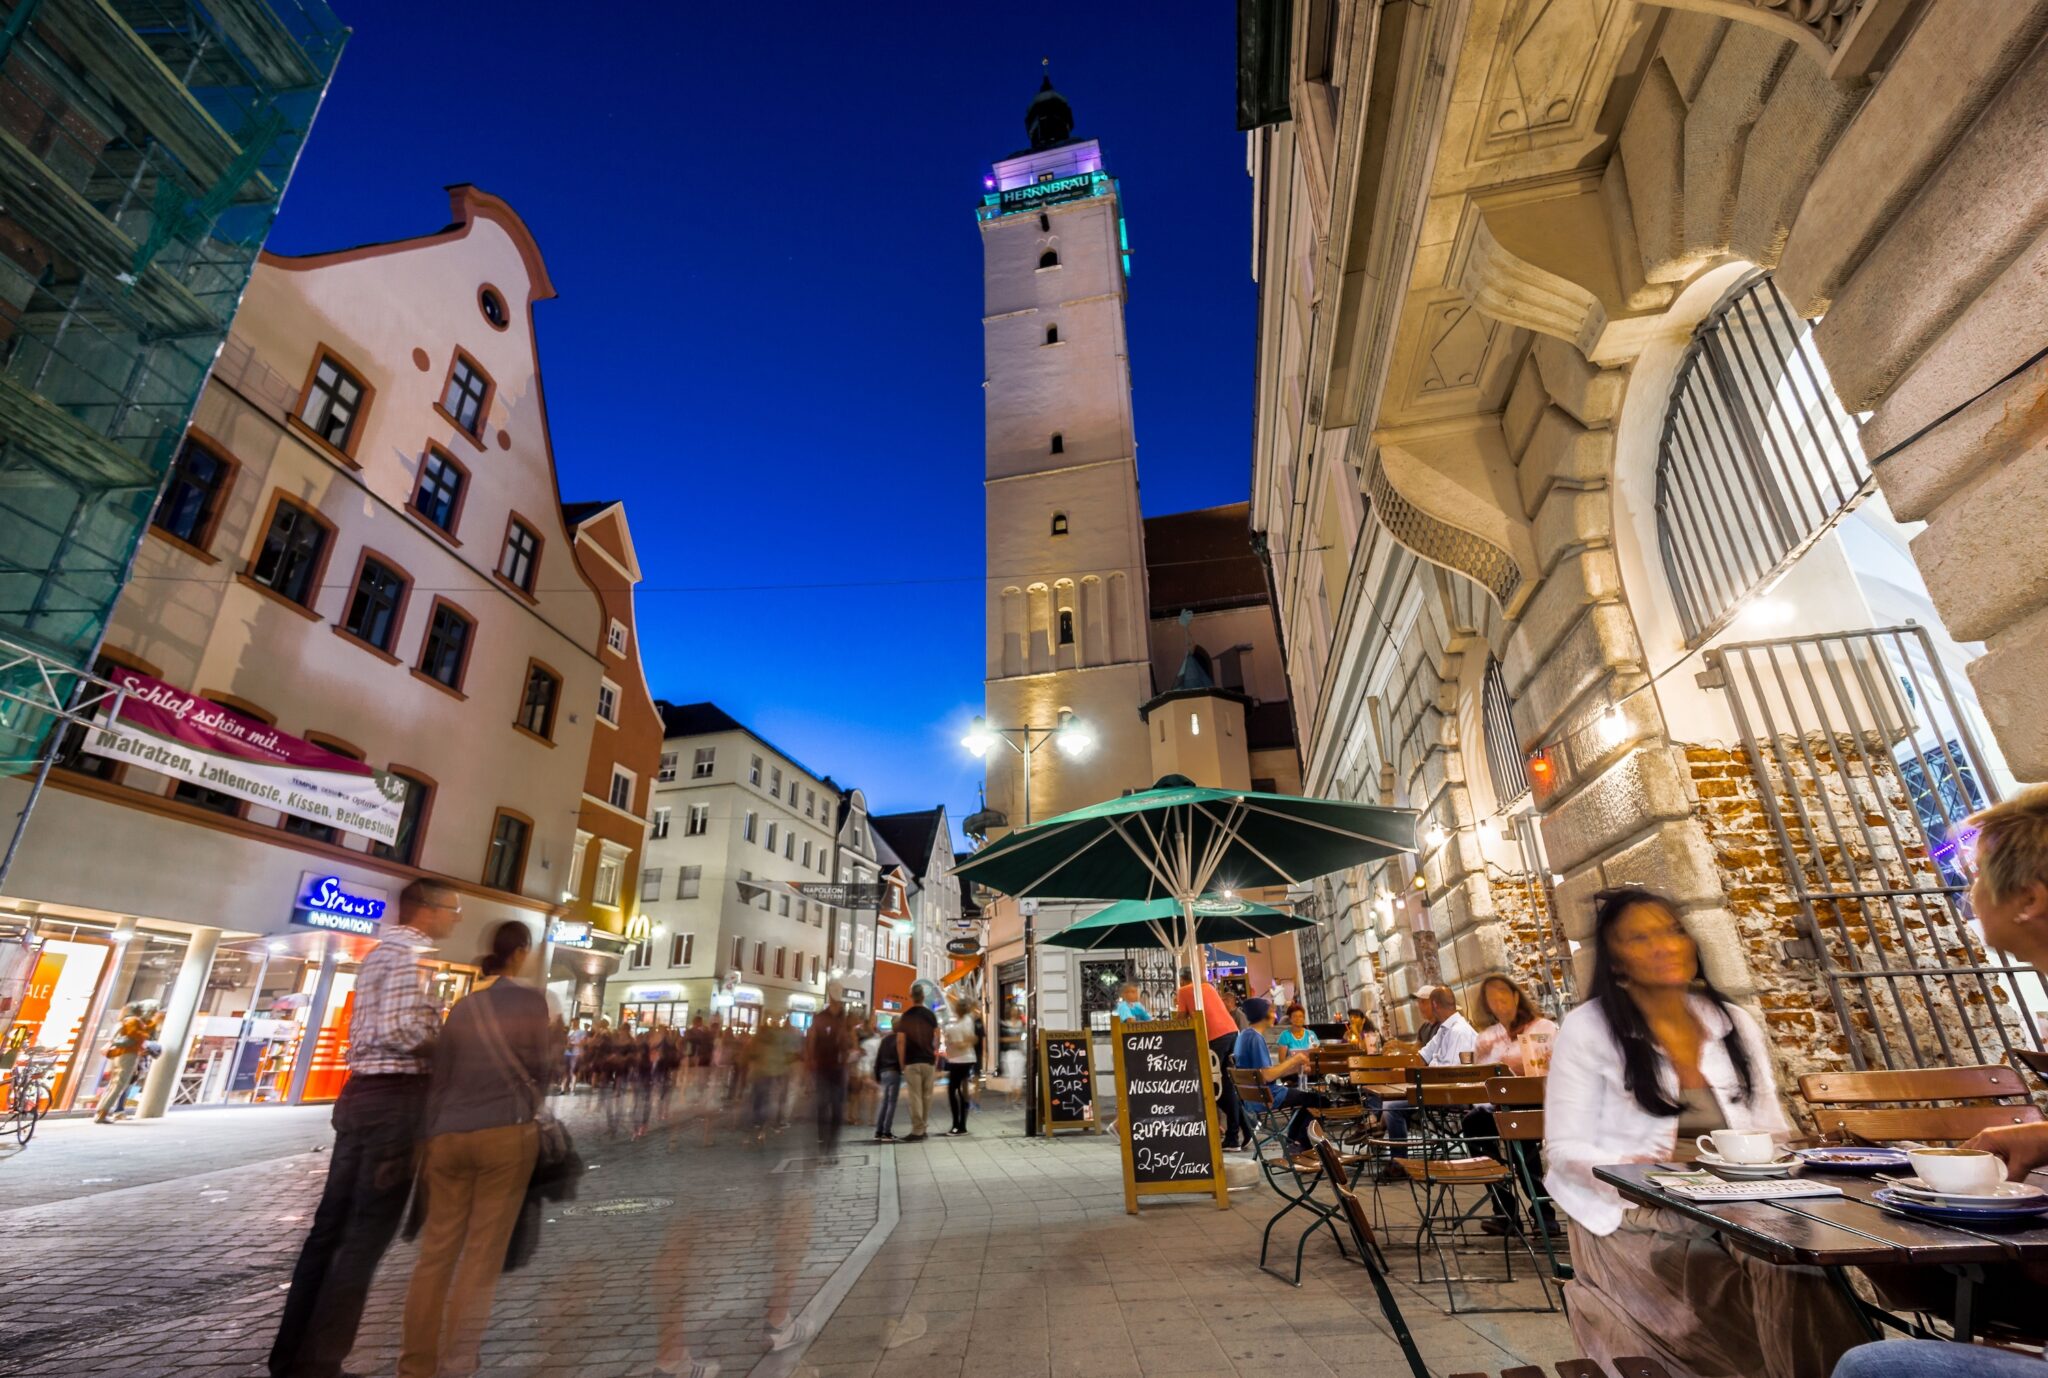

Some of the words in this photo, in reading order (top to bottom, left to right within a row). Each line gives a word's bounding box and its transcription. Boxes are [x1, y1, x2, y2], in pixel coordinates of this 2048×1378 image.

[123, 677, 195, 719] Schlaf
[191, 709, 246, 738] schön
[95, 731, 194, 775] Matratzen,
[199, 762, 283, 804] Lattenroste,
[286, 792, 332, 819] Kissen,
[336, 807, 395, 839] Bettgestelle
[310, 877, 381, 916] Straus
[803, 886, 844, 894] NAPOLEON
[308, 910, 374, 935] INNOVATION
[25, 983, 51, 999] ALE
[1127, 1035, 1163, 1051] GANZ
[1050, 1064, 1084, 1076] WALK
[1053, 1079, 1083, 1095] BAR
[1128, 1079, 1200, 1096] NUSSKUCHEN
[1150, 1104, 1176, 1115] ODER
[1132, 1119, 1207, 1141] ZUPFKUCHEN
